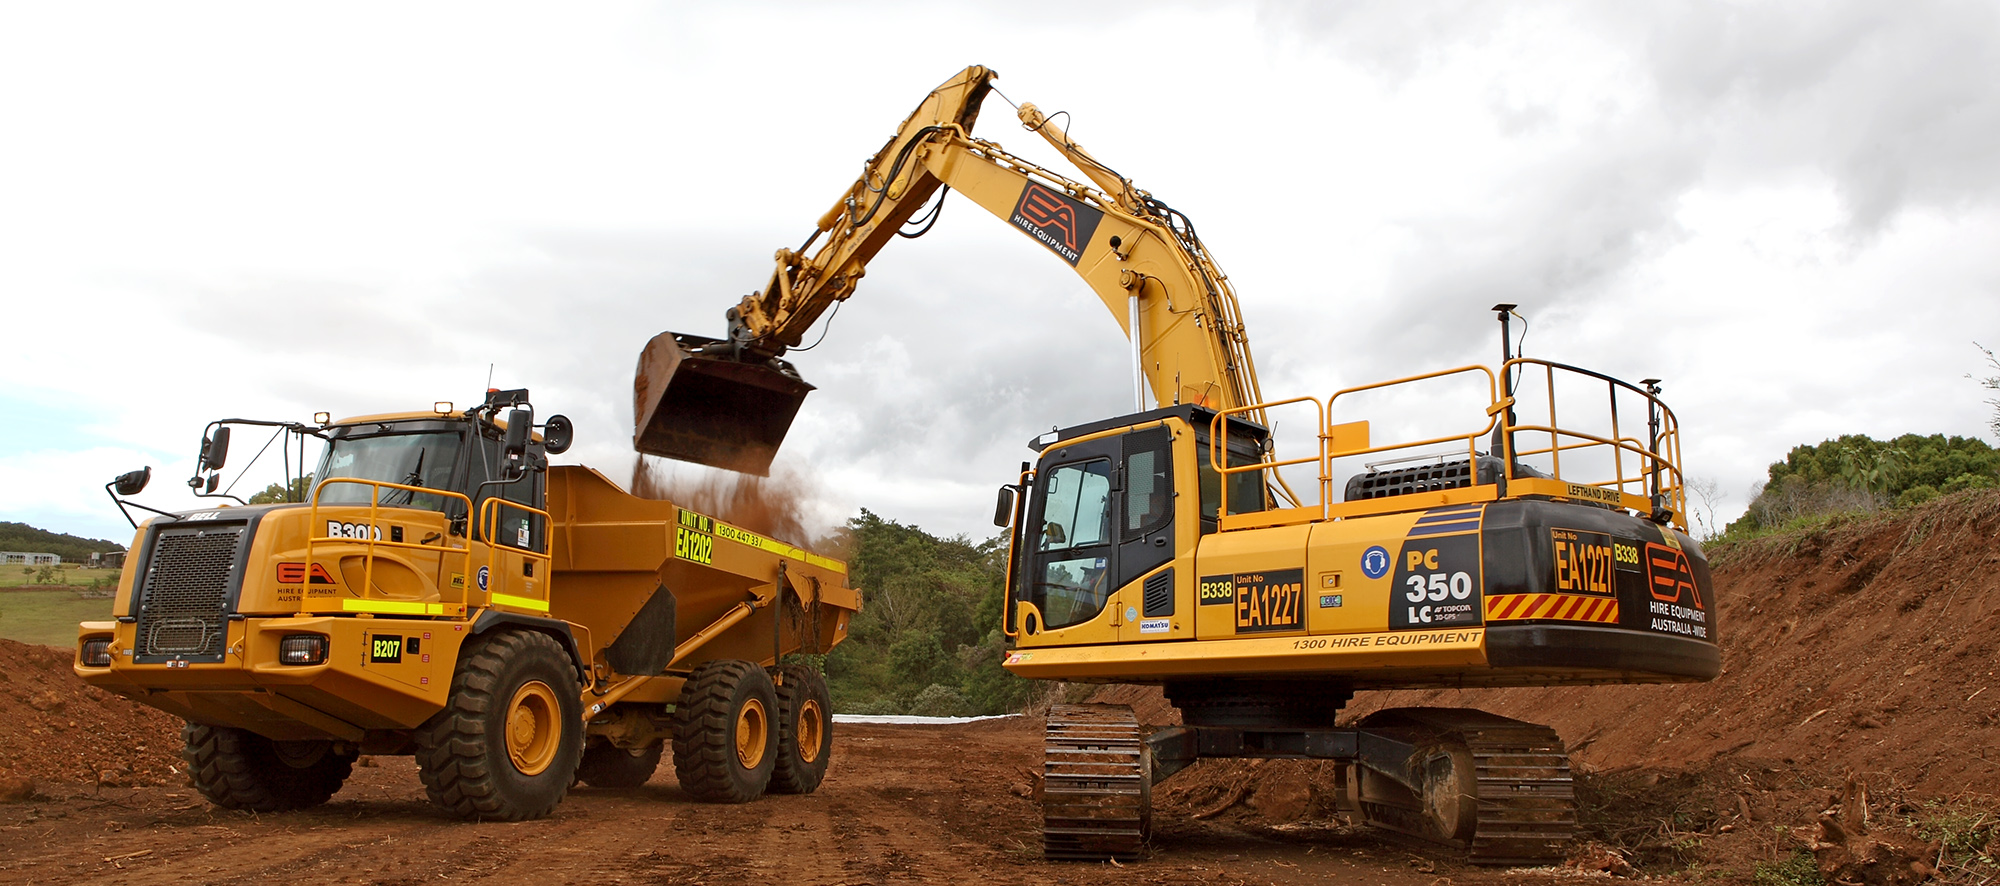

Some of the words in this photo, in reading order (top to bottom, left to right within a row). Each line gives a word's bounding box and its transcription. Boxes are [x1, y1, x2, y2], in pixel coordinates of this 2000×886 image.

[1020, 184, 1077, 251] EA
[1013, 214, 1032, 232] HIRE
[1031, 228, 1079, 262] EQUIPMENT
[1567, 484, 1602, 500] LEFTHAND
[1602, 490, 1620, 503] DRIVE
[326, 520, 382, 543] B30D
[681, 509, 697, 528] UNIT
[698, 515, 711, 533] NO.
[718, 525, 736, 539] 1300
[736, 531, 750, 543] 447
[1552, 530, 1567, 540] Unit
[1567, 532, 1578, 541] No
[675, 527, 713, 565] EA1202
[1614, 543, 1639, 565] B338
[1407, 548, 1439, 572] PC
[1555, 541, 1612, 594] EA1227
[276, 562, 336, 584] EA
[1236, 575, 1252, 584] Unit
[1252, 574, 1264, 583] No
[1645, 541, 1704, 610] EA
[1201, 580, 1233, 599] B338
[1405, 571, 1473, 603] 350
[1237, 582, 1302, 628] EA1227
[1408, 605, 1432, 624] LC
[1649, 600, 1670, 616] HIRE
[1670, 604, 1706, 623] EQUIPMENT
[1141, 621, 1169, 630] KOMATSU
[1651, 617, 1692, 635] AUSTRALIA
[373, 640, 400, 658] B207
[1292, 639, 1327, 650] 1300
[1330, 636, 1371, 648] HIRE
[1374, 632, 1482, 646] EQUIPMENT
